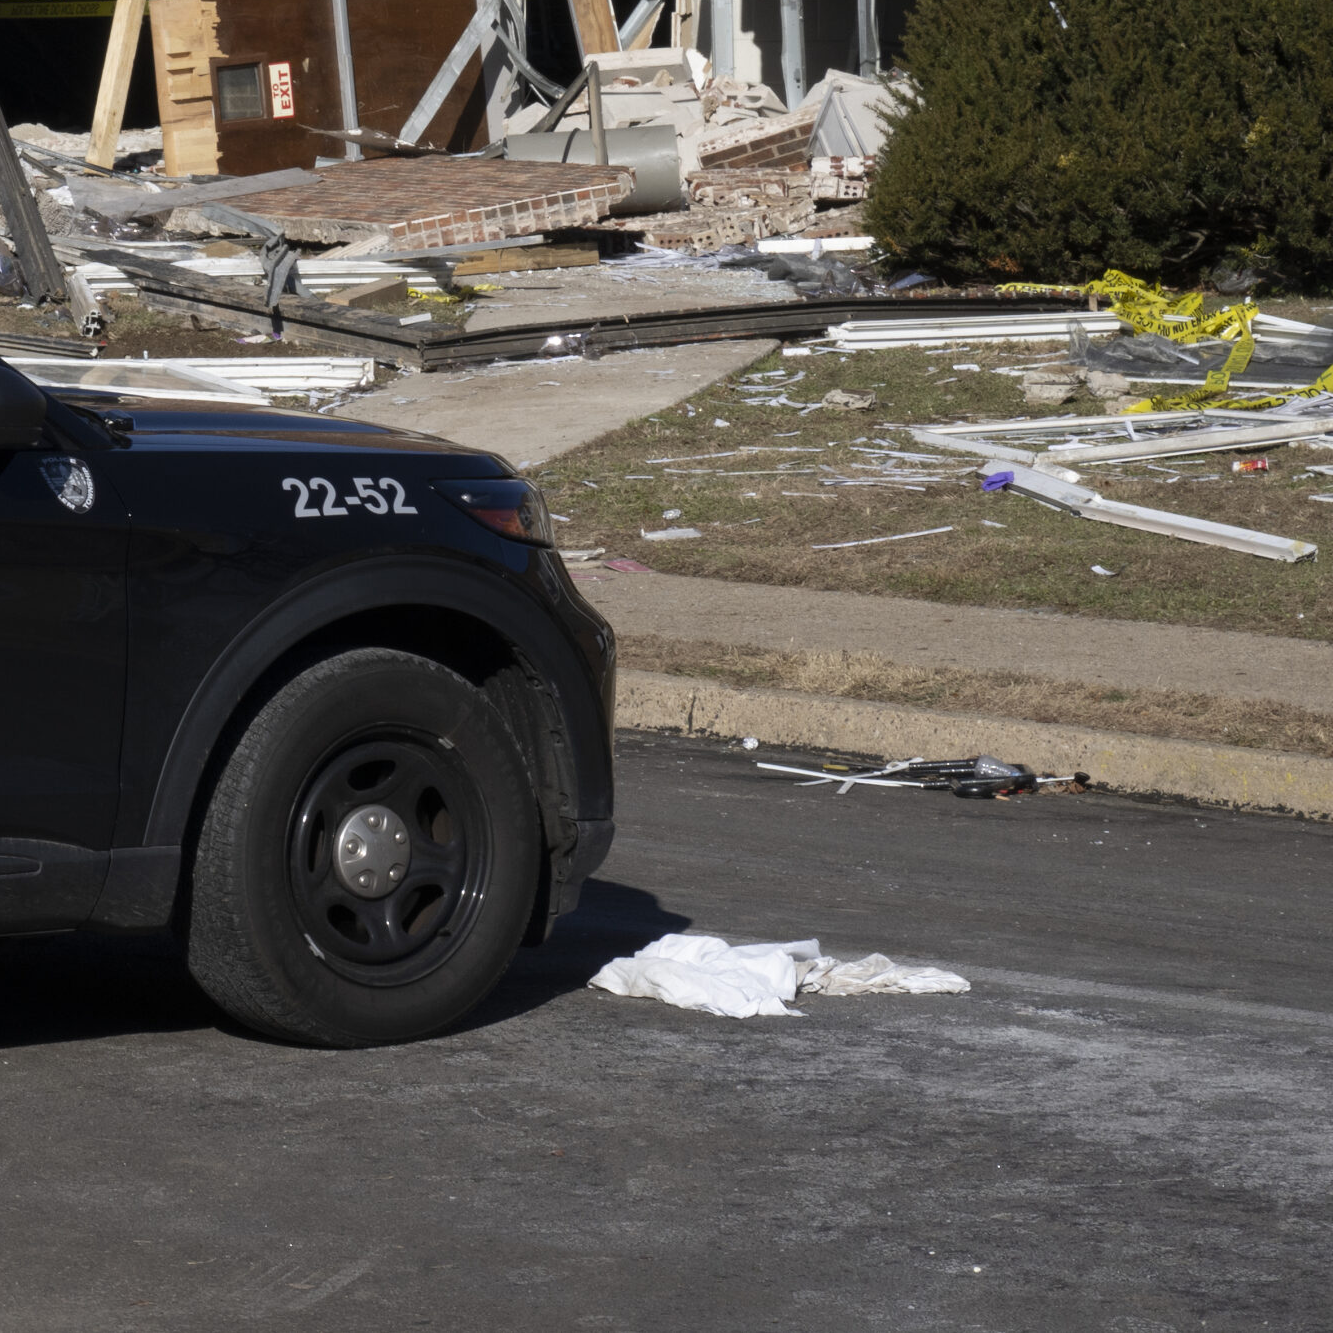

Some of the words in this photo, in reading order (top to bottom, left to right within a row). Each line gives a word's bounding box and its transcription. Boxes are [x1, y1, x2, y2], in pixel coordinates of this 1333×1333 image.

[273, 83, 279, 98] TO
[278, 70, 291, 109] EXIT
[282, 477, 419, 518] 22-52
